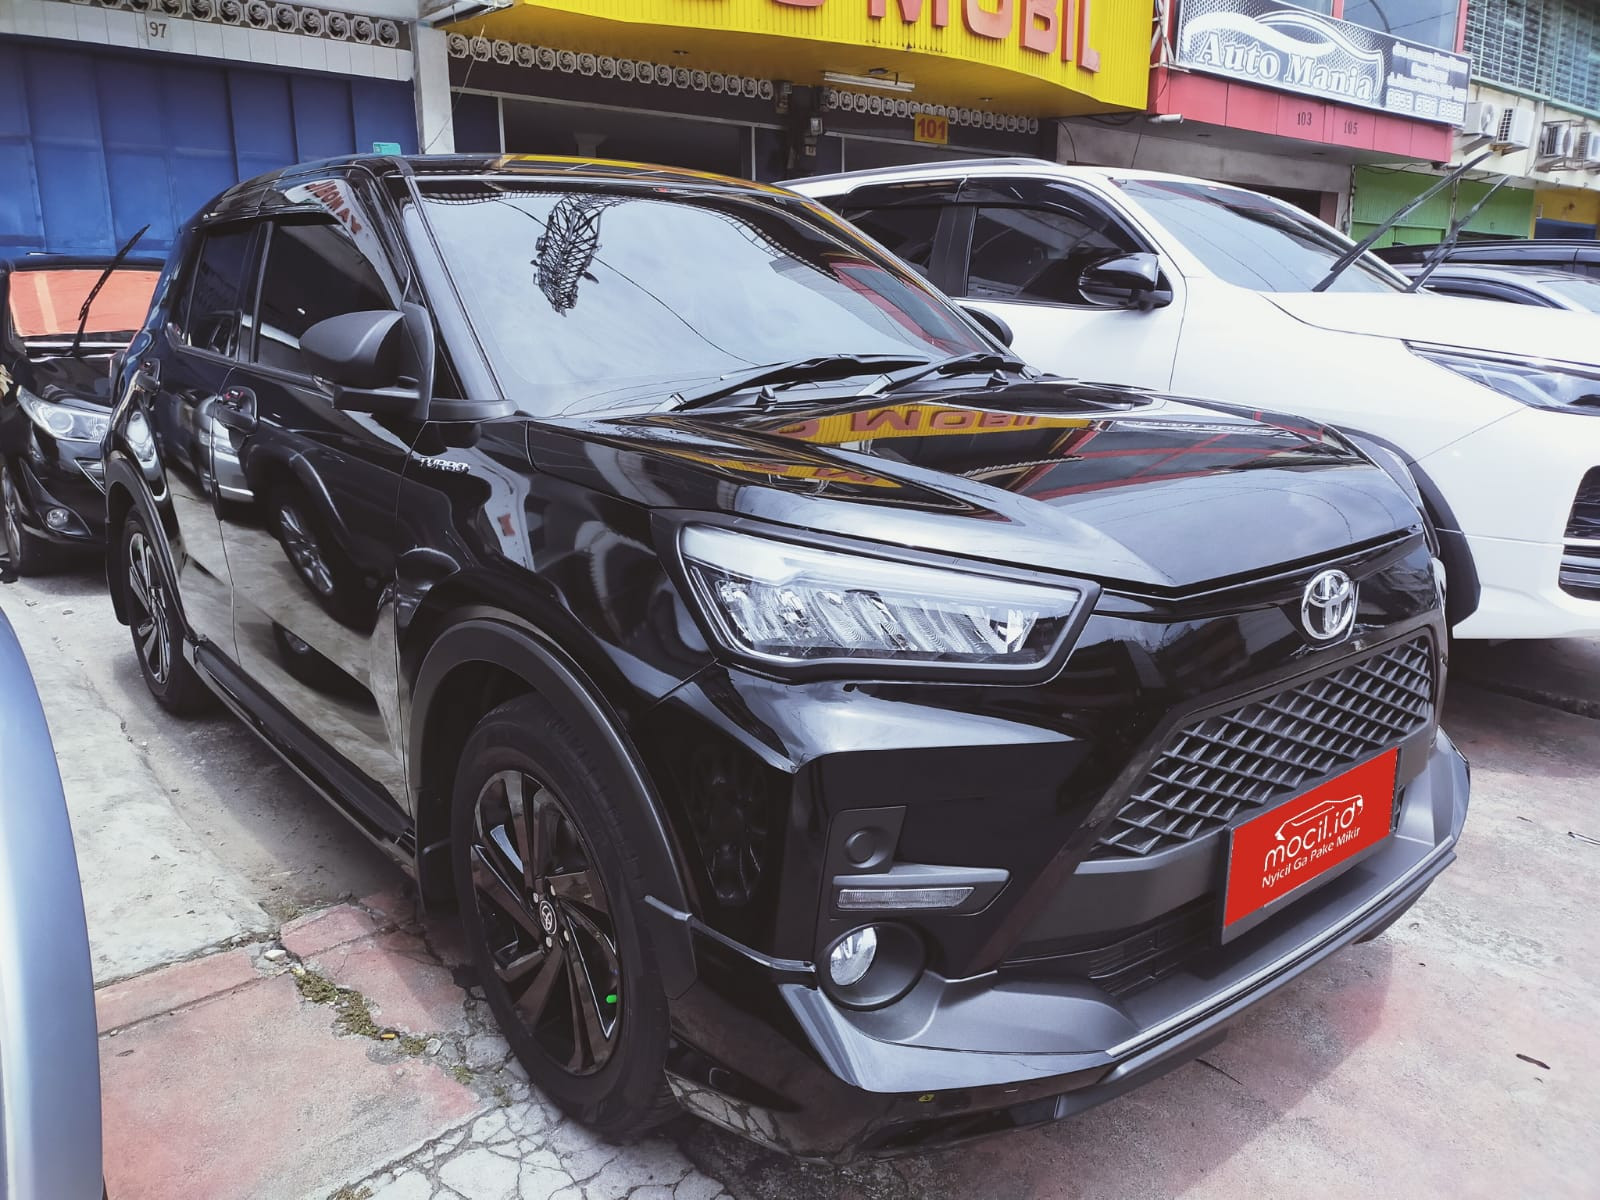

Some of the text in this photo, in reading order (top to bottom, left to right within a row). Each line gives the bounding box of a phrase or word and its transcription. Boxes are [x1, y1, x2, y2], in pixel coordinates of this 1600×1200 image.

[150, 21, 167, 38] 97
[1196, 32, 1280, 79] Auto
[1284, 54, 1372, 101] Mania
[1297, 112, 1312, 126] 103
[917, 117, 946, 139] 101
[1343, 120, 1358, 135] 105
[420, 457, 471, 472] TURBO
